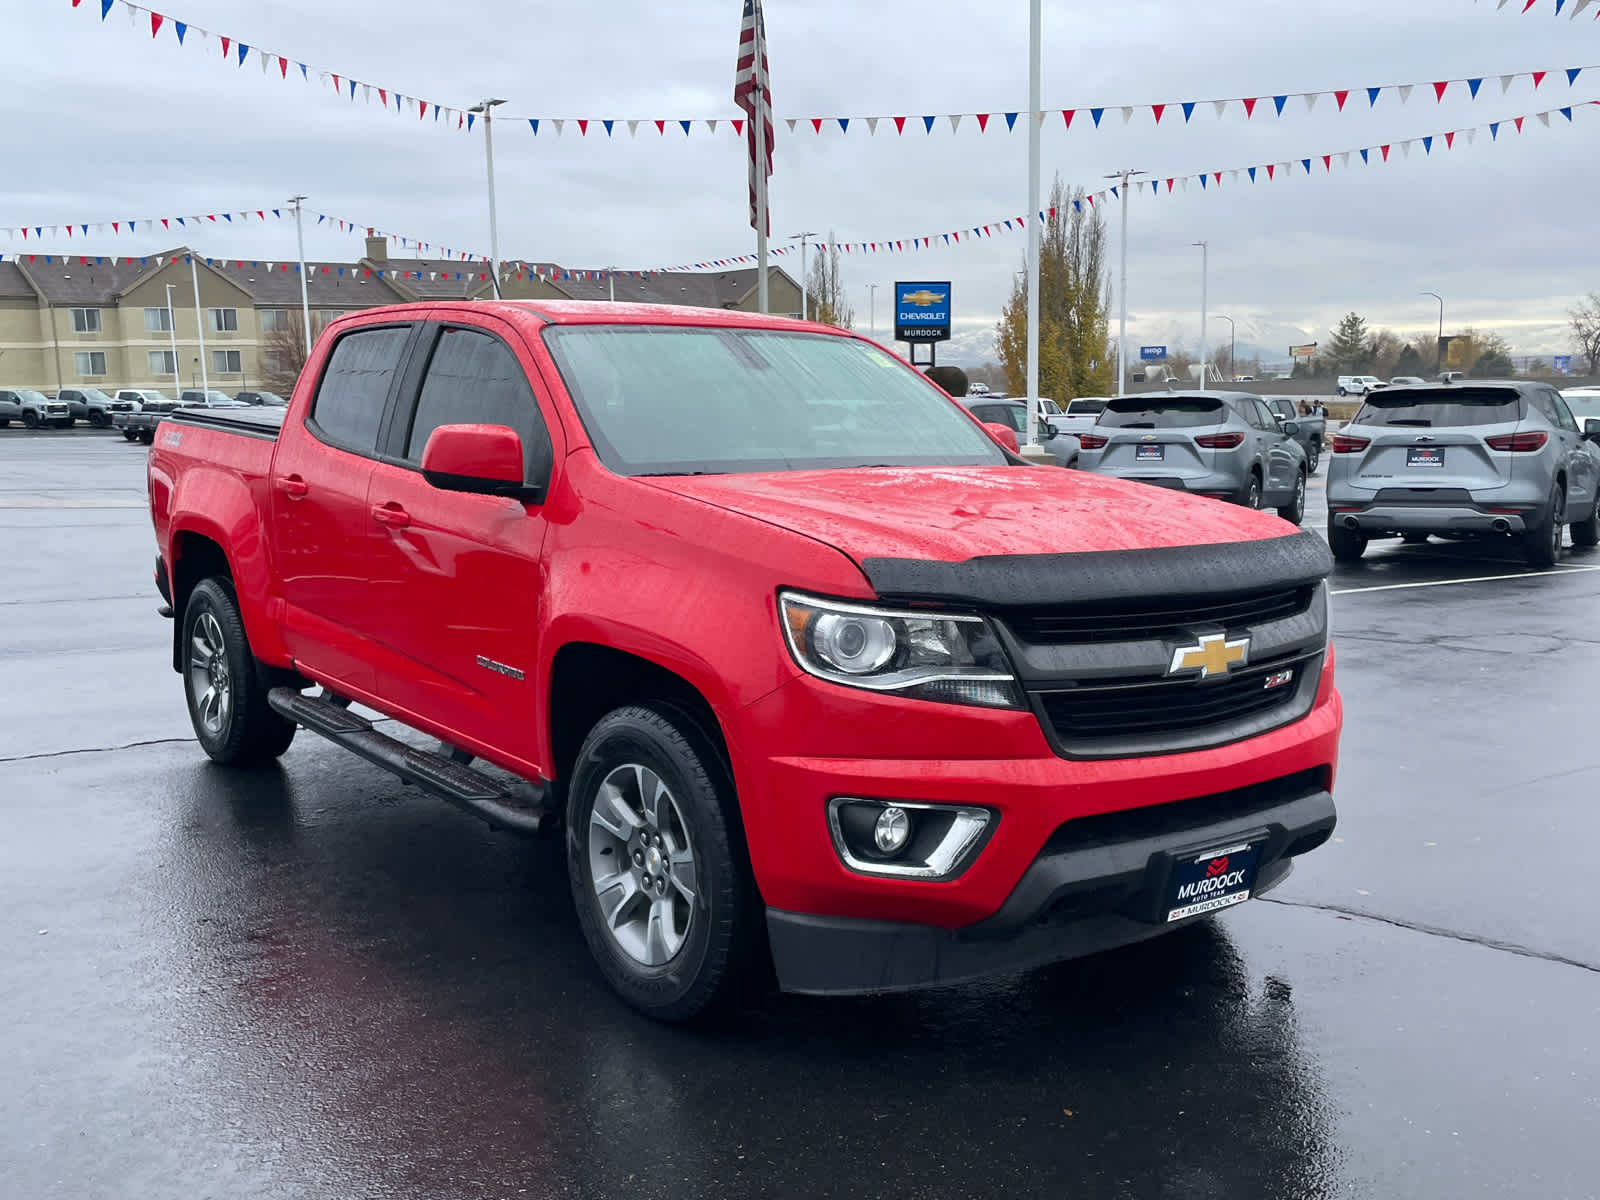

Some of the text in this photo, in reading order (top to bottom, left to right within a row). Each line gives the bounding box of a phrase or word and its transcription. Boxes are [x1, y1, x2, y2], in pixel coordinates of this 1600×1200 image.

[900, 312, 946, 320] CHEVROLET
[904, 329, 942, 337] MURDOCK
[1177, 869, 1246, 900] MURDOCK
[1192, 889, 1225, 903] AUTO TEAM
[1187, 897, 1232, 914] MURDOCK
